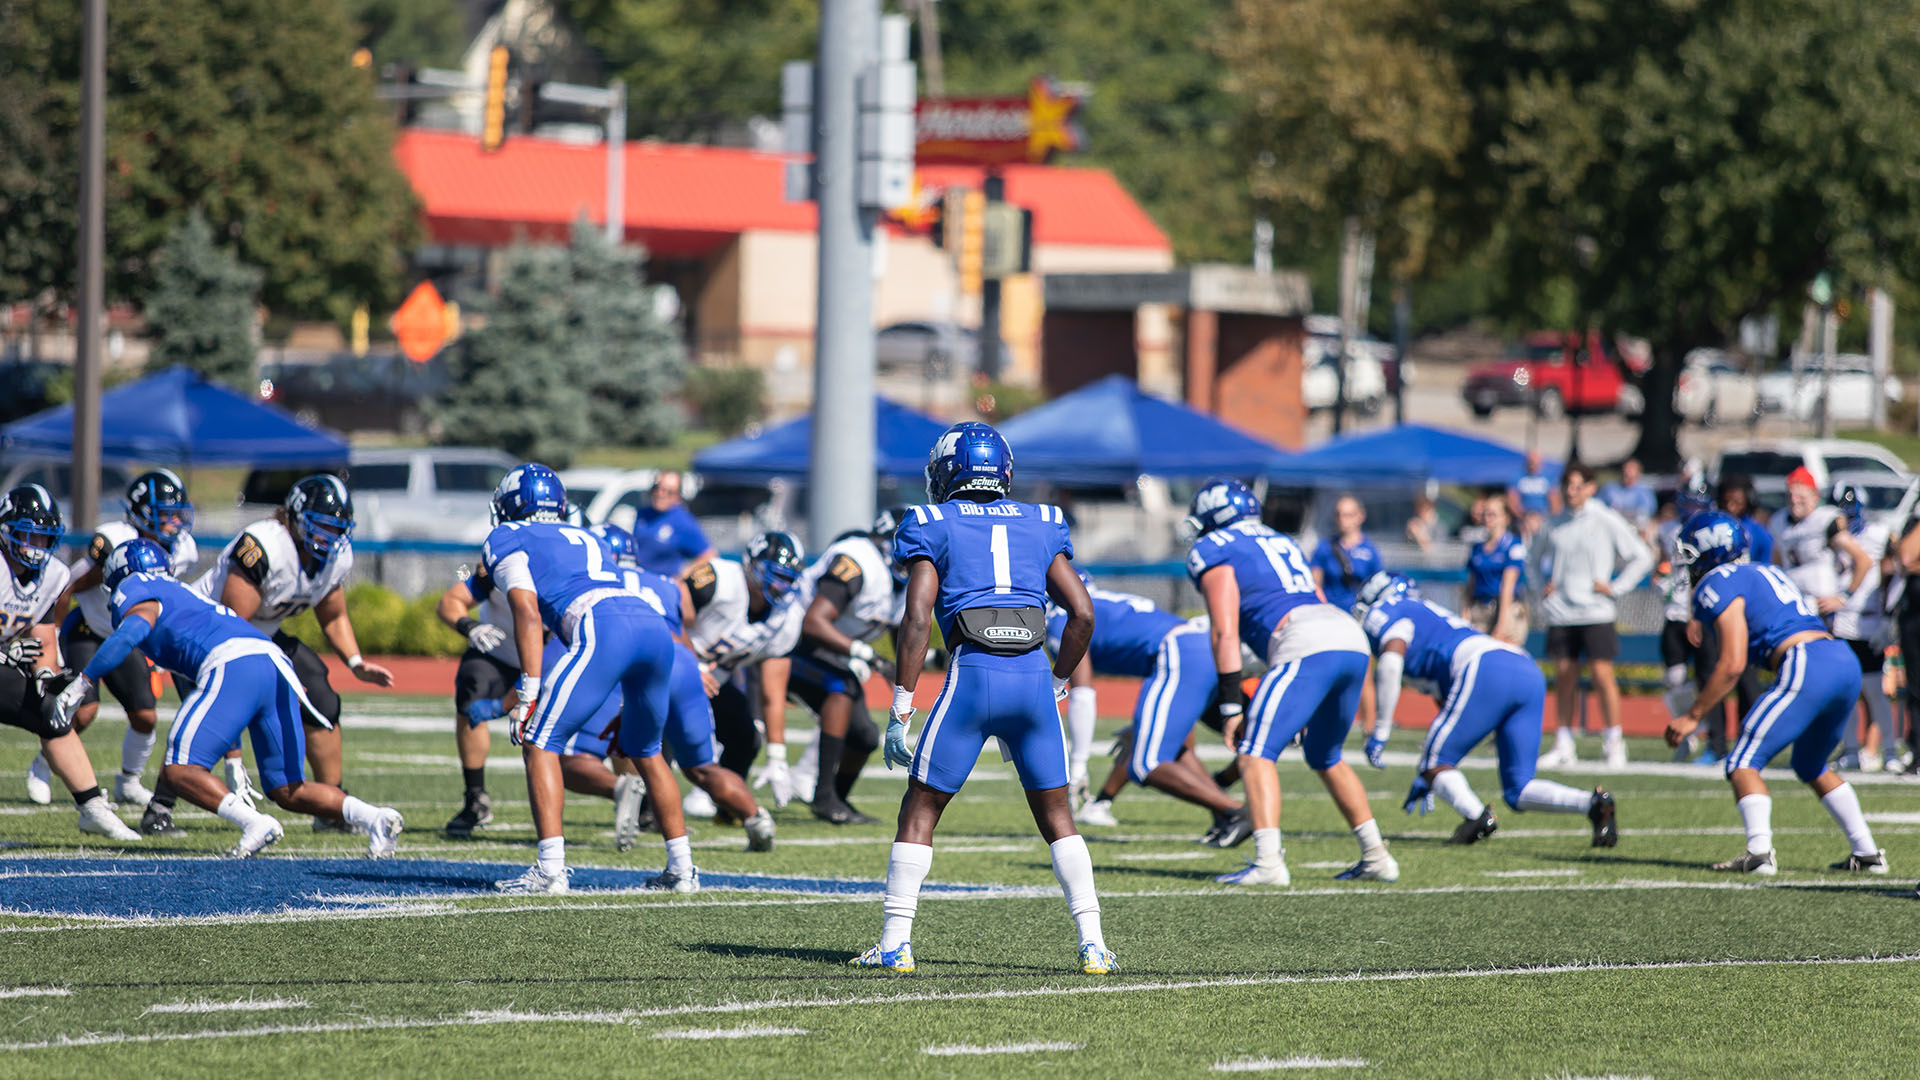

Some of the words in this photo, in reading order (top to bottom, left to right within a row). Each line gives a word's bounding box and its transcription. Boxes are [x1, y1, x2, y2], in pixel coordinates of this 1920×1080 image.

[236, 534, 263, 569] 76
[558, 527, 620, 582] 2
[990, 524, 1012, 595] 1
[1255, 536, 1317, 594] 13
[988, 629, 1029, 638] BATTLE
